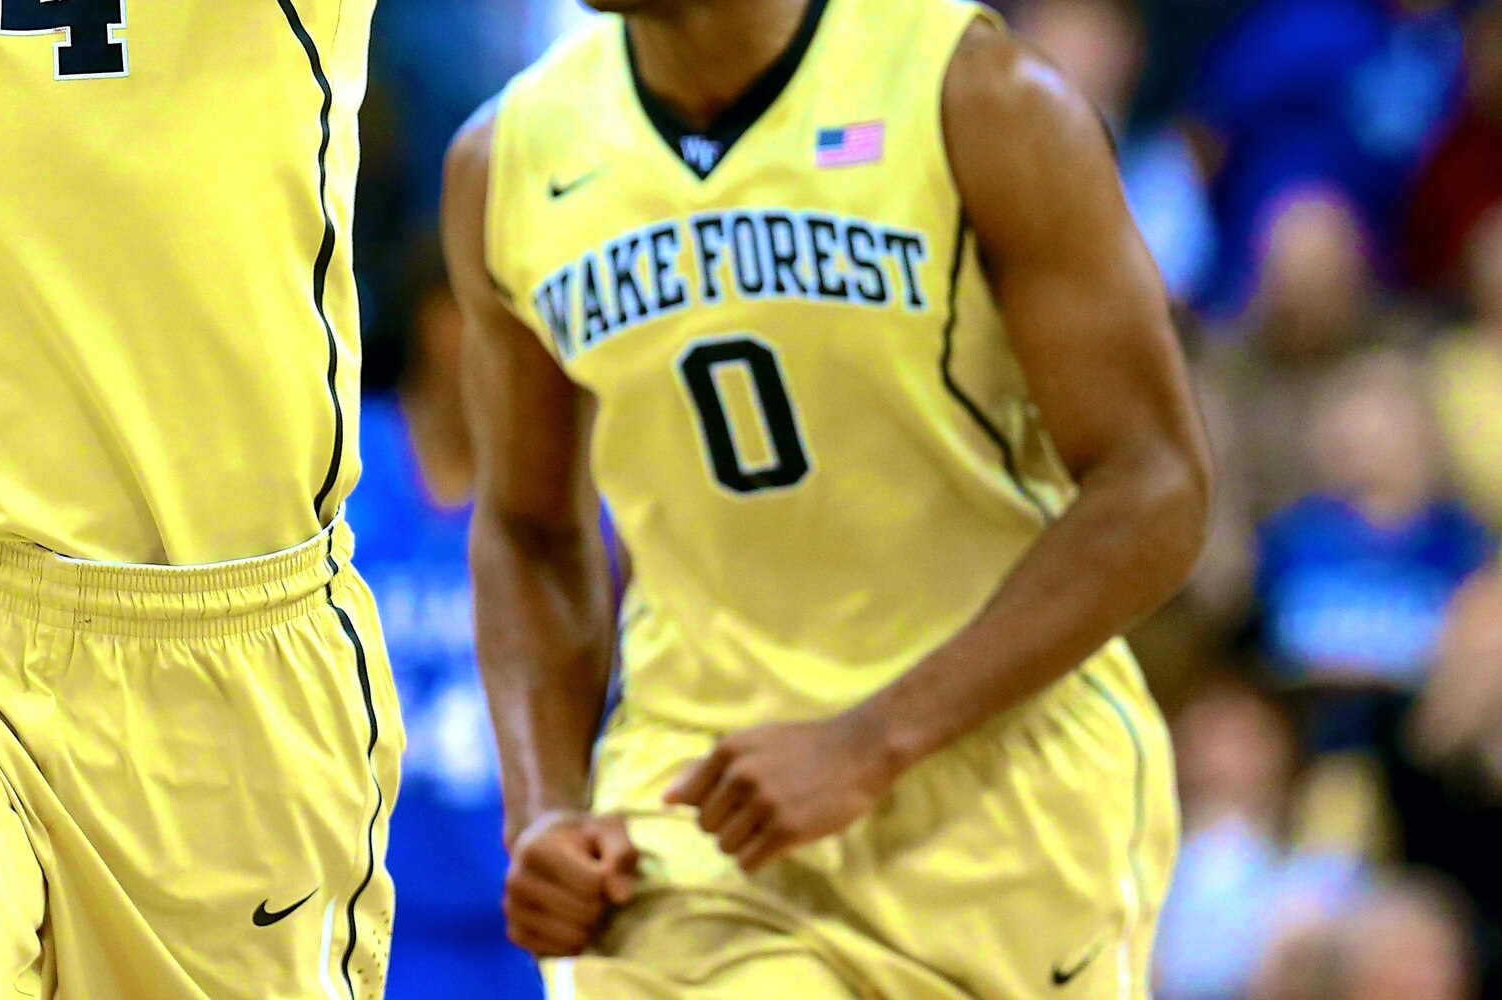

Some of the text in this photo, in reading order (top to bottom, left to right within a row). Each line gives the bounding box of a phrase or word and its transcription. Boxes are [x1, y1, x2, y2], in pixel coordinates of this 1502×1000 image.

[534, 209, 926, 360] WAKE FOREST
[675, 332, 811, 495] 0
